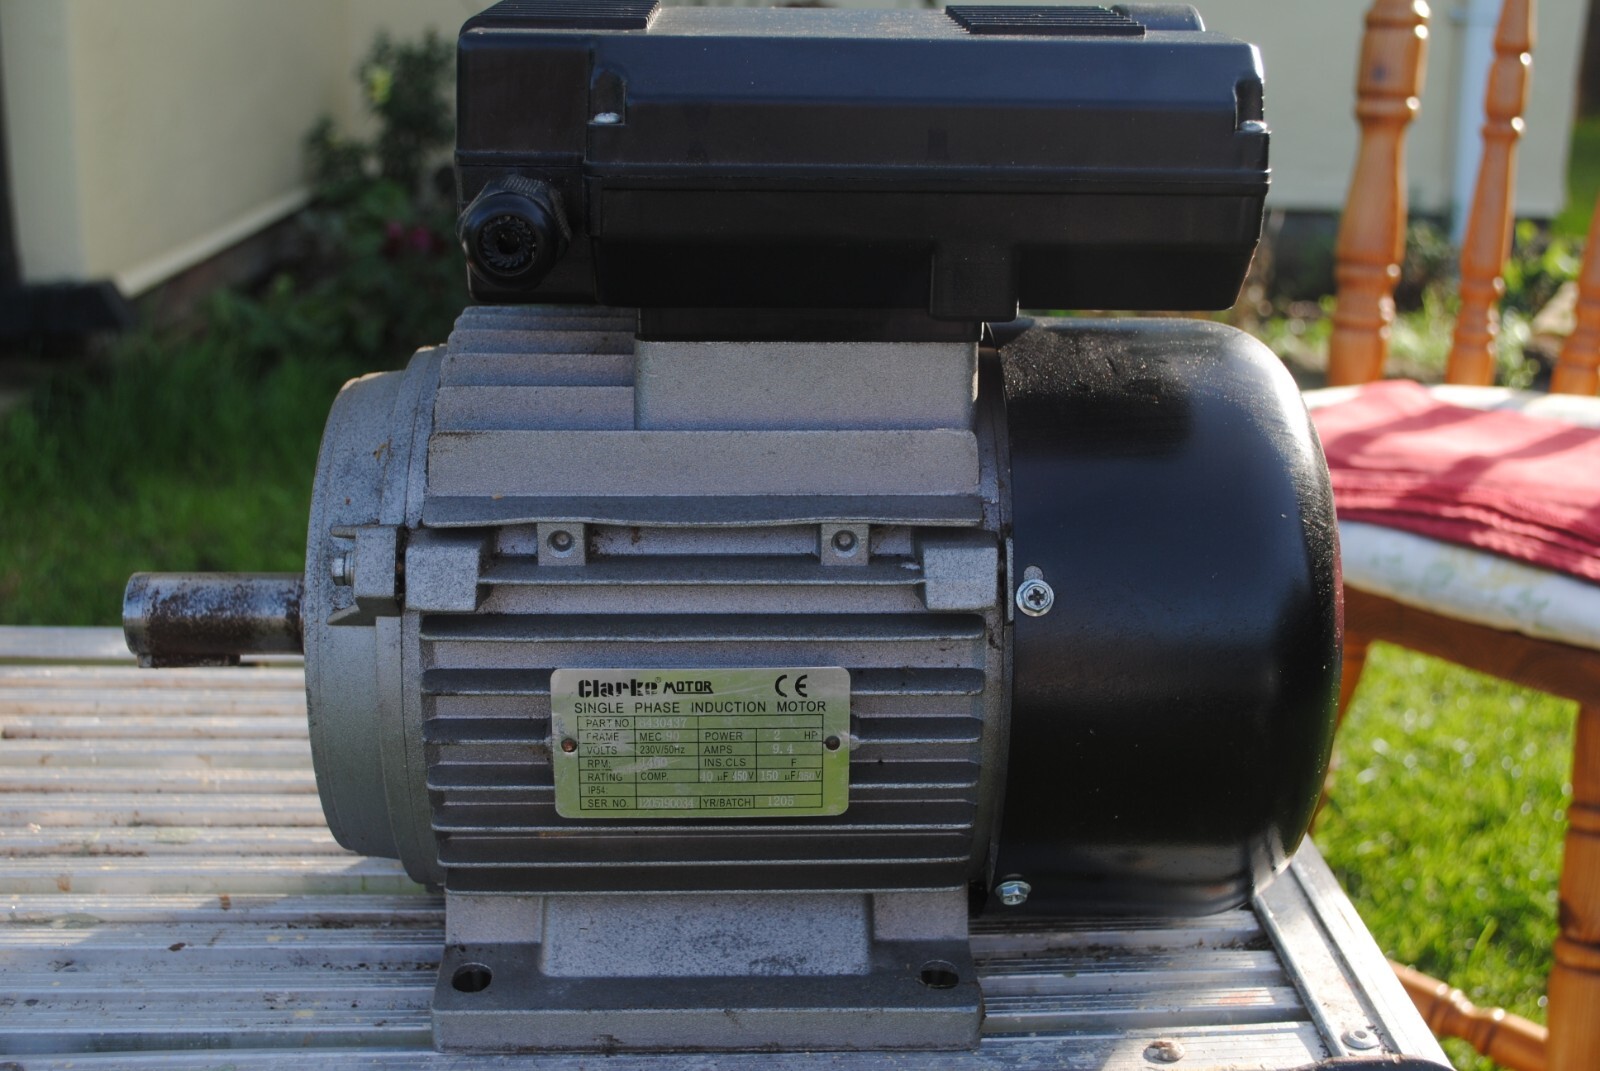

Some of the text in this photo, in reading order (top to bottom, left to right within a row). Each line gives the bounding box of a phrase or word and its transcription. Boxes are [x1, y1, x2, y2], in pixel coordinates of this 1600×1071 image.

[578, 679, 714, 698] Clarke MOTOR
[775, 674, 808, 698] CE
[574, 701, 826, 714] SINGLE PHASE INDUCTION MOTOR
[586, 718, 613, 728] PART
[587, 732, 620, 742] FRAME
[640, 732, 662, 741] MEC
[705, 732, 743, 740] POWER
[774, 731, 818, 740] 2 HP
[587, 746, 618, 754] VOLTS
[640, 745, 685, 754] 230V/50Hz
[704, 746, 733, 754] AMPS
[792, 758, 796, 767] F
[588, 773, 622, 782] RATING
[761, 770, 779, 781] 150
[703, 798, 750, 808] YR/BATCH
[767, 796, 794, 806] 1205
